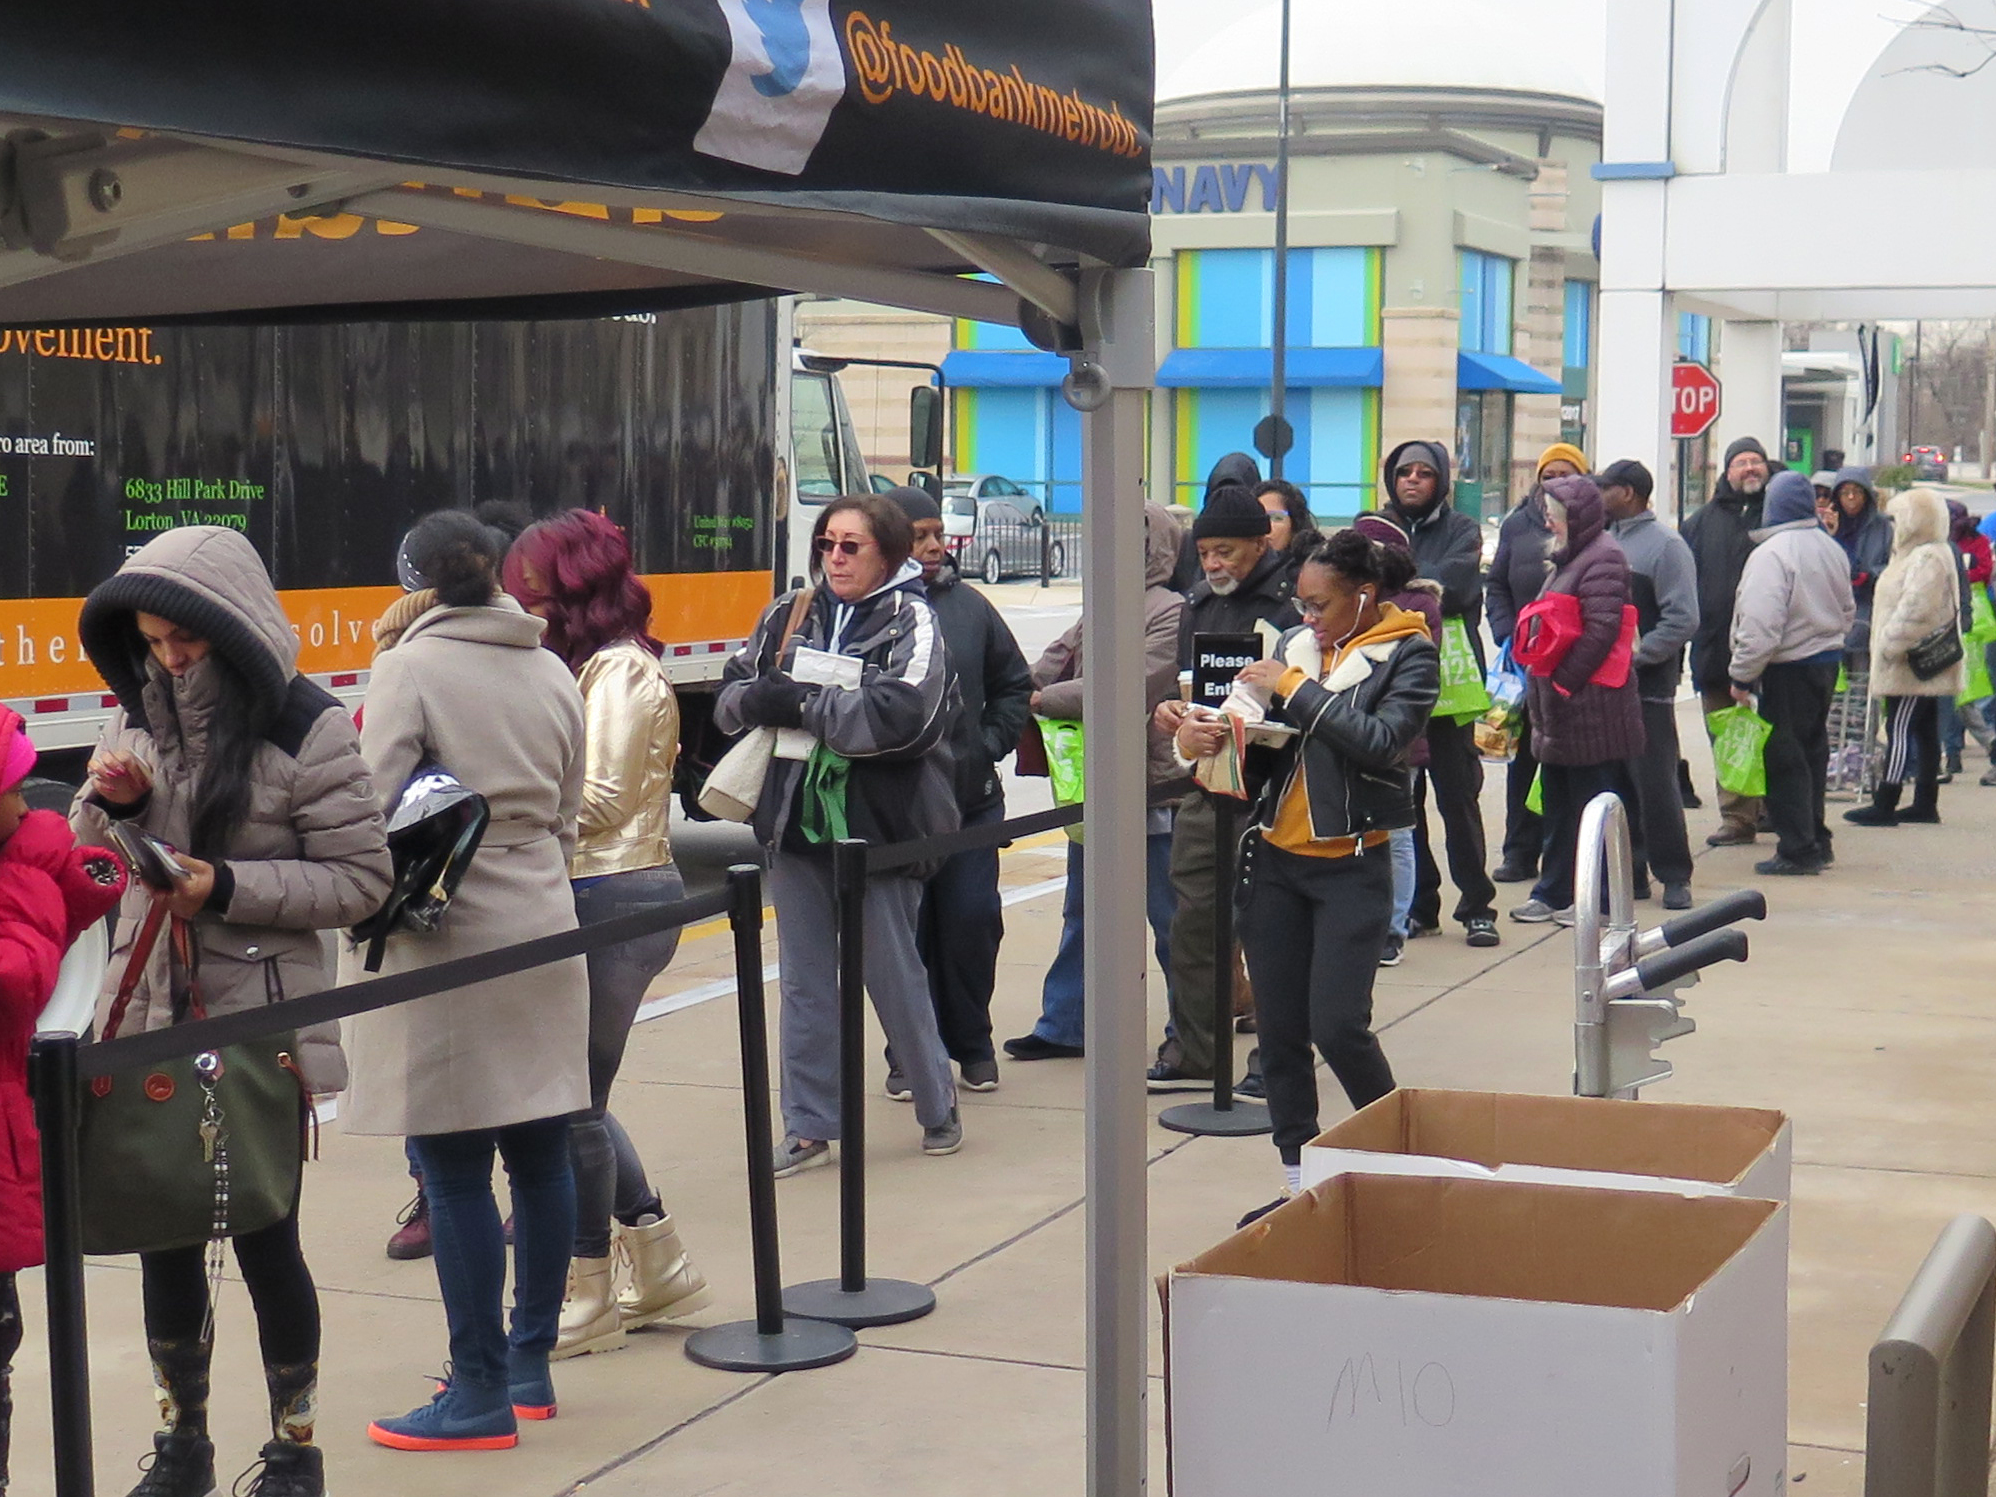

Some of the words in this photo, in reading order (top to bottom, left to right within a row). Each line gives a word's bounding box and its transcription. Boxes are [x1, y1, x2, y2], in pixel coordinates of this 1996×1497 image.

[1151, 163, 1279, 214] NAVY
[1672, 386, 1715, 414] TOP
[15, 437, 49, 455] area
[52, 432, 95, 456] from:
[125, 478, 163, 503] 6833
[166, 478, 191, 499] Hill
[195, 478, 226, 499] Park
[229, 479, 265, 499] Drive
[181, 510, 200, 527] VA
[1200, 653, 1254, 668] Please
[1204, 681, 1233, 697] Ent
